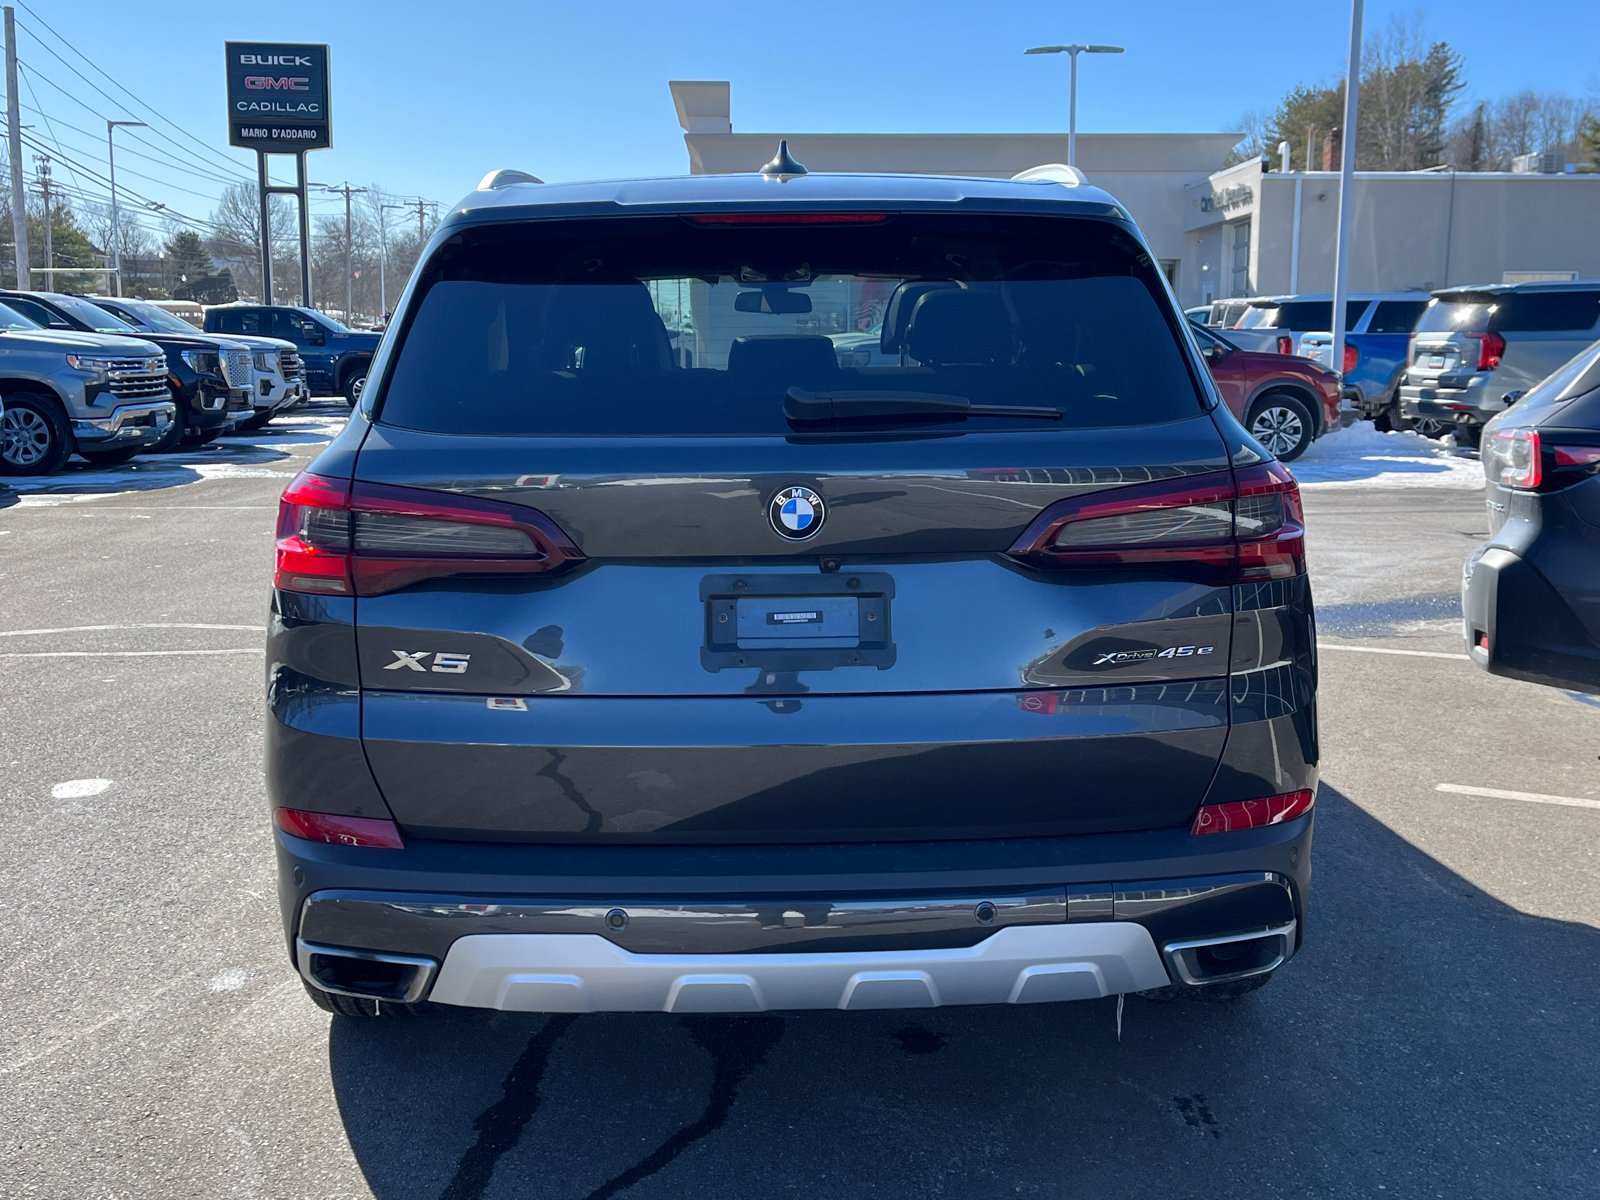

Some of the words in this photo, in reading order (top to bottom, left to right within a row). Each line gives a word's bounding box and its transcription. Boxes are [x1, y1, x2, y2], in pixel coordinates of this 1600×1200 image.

[240, 54, 312, 66] BUICK
[245, 76, 309, 90] GMC
[236, 101, 319, 112] CADILLAC
[241, 128, 268, 138] MARIO
[272, 128, 317, 139] D'ADDARIO
[775, 488, 820, 506] BMW
[382, 649, 472, 674] X5
